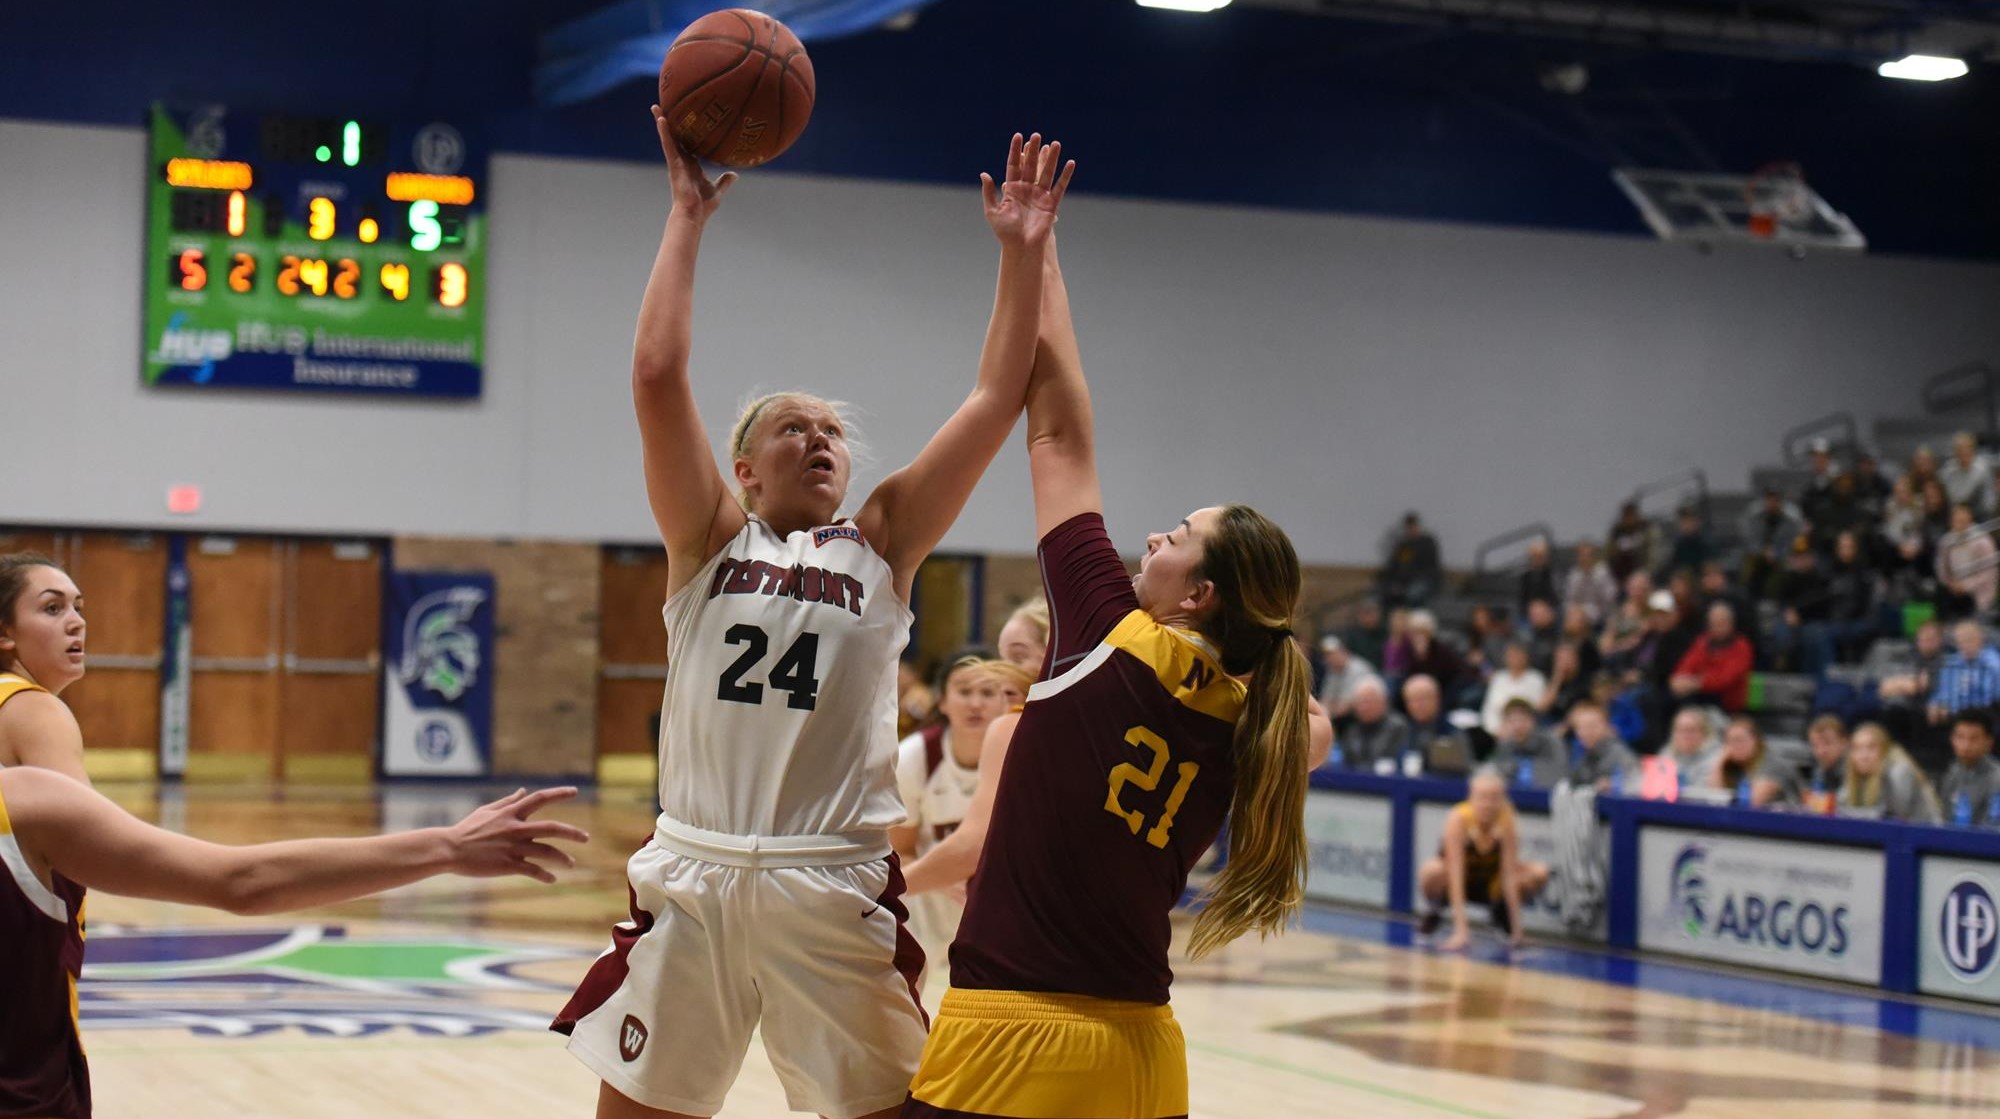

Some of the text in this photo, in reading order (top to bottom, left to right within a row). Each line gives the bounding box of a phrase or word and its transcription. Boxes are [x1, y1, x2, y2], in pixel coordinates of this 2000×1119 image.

[439, 261, 467, 307] 3
[717, 623, 819, 711] 24
[1180, 656, 1216, 691] N
[1103, 725, 1200, 849] 21
[1716, 895, 1848, 955] ARGOS
[625, 1023, 644, 1053] W
